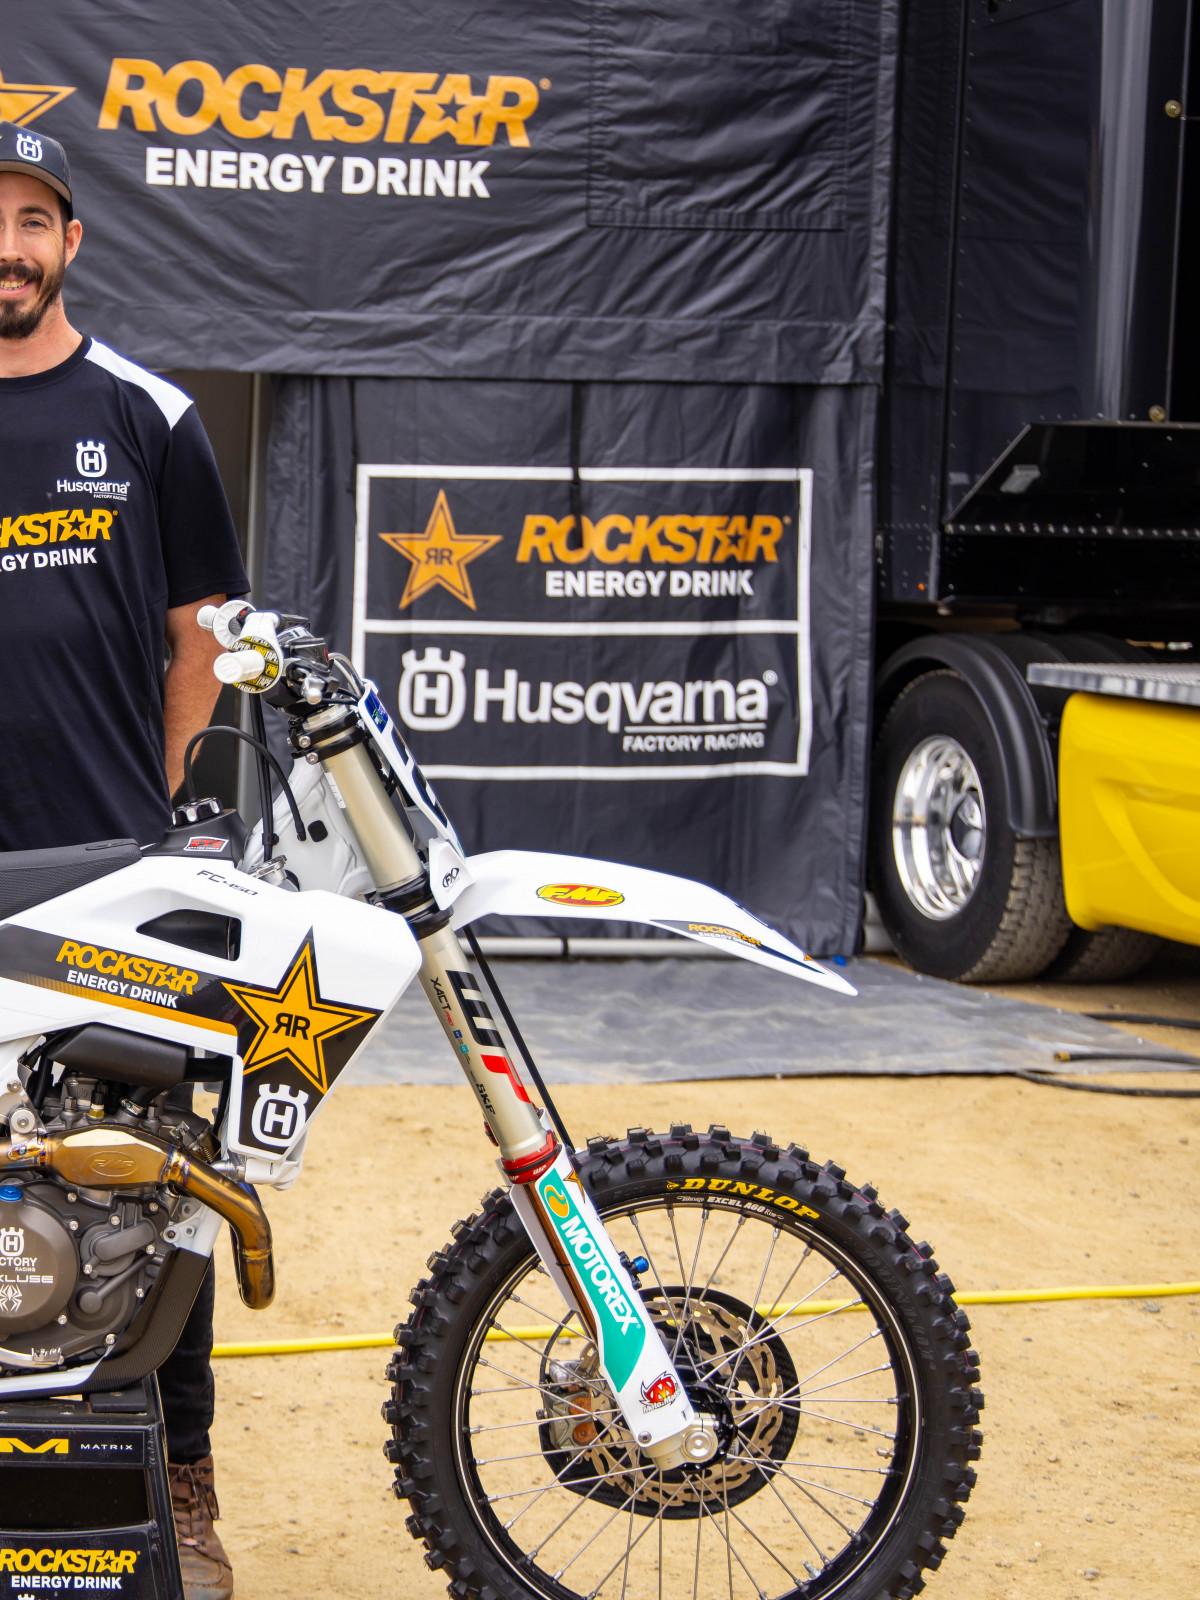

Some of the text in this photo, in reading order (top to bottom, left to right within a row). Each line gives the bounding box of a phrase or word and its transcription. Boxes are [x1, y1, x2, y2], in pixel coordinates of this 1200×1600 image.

[98, 57, 540, 147] ROCKSTAR
[145, 147, 490, 198] ENERGY DRINK
[56, 479, 128, 494] Husqvarna
[516, 514, 783, 564] ROCKSTAR
[33, 547, 97, 569] DRINK
[546, 569, 754, 597] ENERGY DRINK
[474, 669, 768, 733] Husqvarna
[623, 733, 765, 753] FACTORY RACING
[197, 869, 225, 883] FC
[537, 886, 623, 902] FMF
[56, 940, 199, 995] ROCKSTAR
[66, 969, 178, 1009] ENERGY DRINK
[430, 976, 451, 1011] XACT
[475, 1083, 496, 1116] SKF
[680, 1177, 820, 1220] DUNLOP
[707, 1196, 742, 1208] EXCEL
[744, 1202, 765, 1213] A60
[560, 1215, 640, 1336] MOTOREX
[80, 1443, 133, 1451] MATRIX
[11, 1576, 122, 1589] ENERGY DRINK
